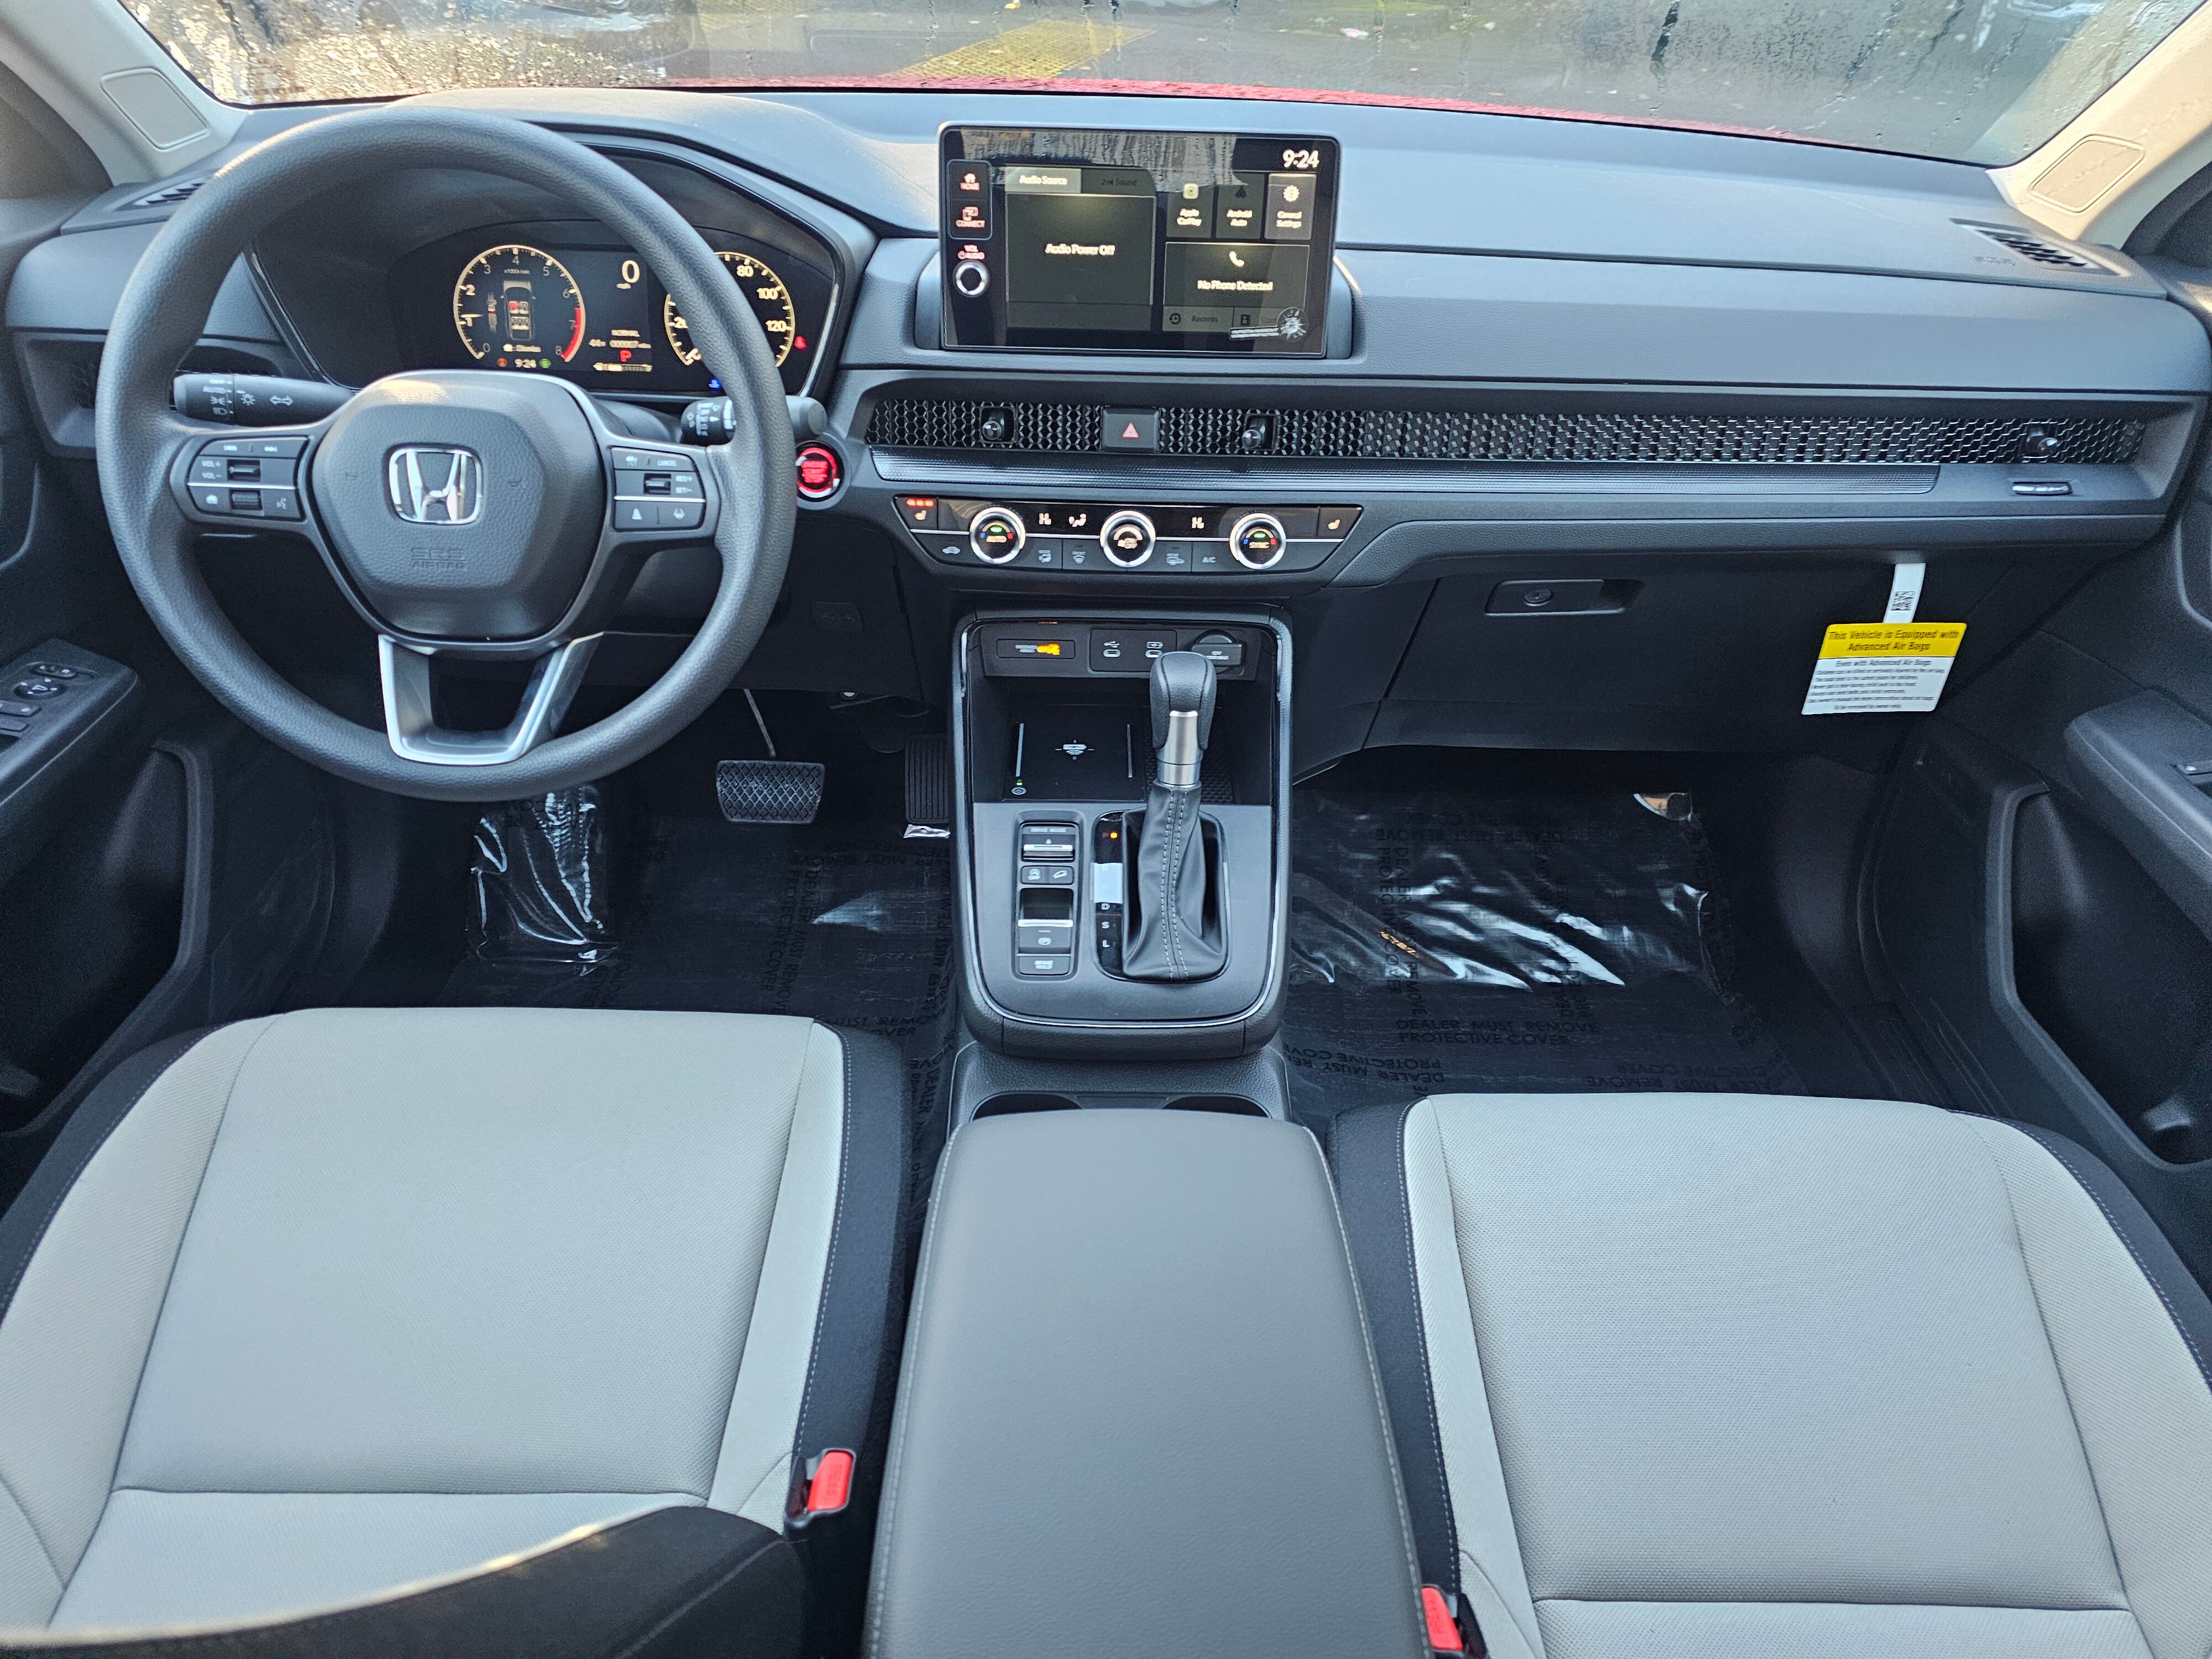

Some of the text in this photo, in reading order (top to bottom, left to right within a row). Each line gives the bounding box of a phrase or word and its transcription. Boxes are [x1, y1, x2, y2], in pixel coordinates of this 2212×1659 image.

[1282, 149, 1319, 168] 9:24
[1115, 178, 1138, 186] Sound
[1045, 243, 1115, 255] Audio Power Off
[512, 255, 519, 265] 4
[484, 264, 491, 274] 3
[542, 266, 550, 276] 5
[622, 260, 640, 283] 0
[736, 265, 754, 277] 80
[466, 284, 476, 296] 2
[1197, 280, 1273, 291] No Phone Detected
[757, 287, 779, 300] 100
[1191, 315, 1218, 324] Recents
[765, 320, 787, 332] 120
[483, 343, 491, 352] 0
[620, 350, 632, 362] P
[1828, 629, 1960, 640] This Vehicle is Equipped with
[1846, 641, 1932, 652] Advanced Air Bags
[1396, 1019, 1460, 1030] DEALER
[1525, 1021, 1600, 1034] REMOVE
[1400, 1032, 1569, 1046] PROTECTIVE COVER
